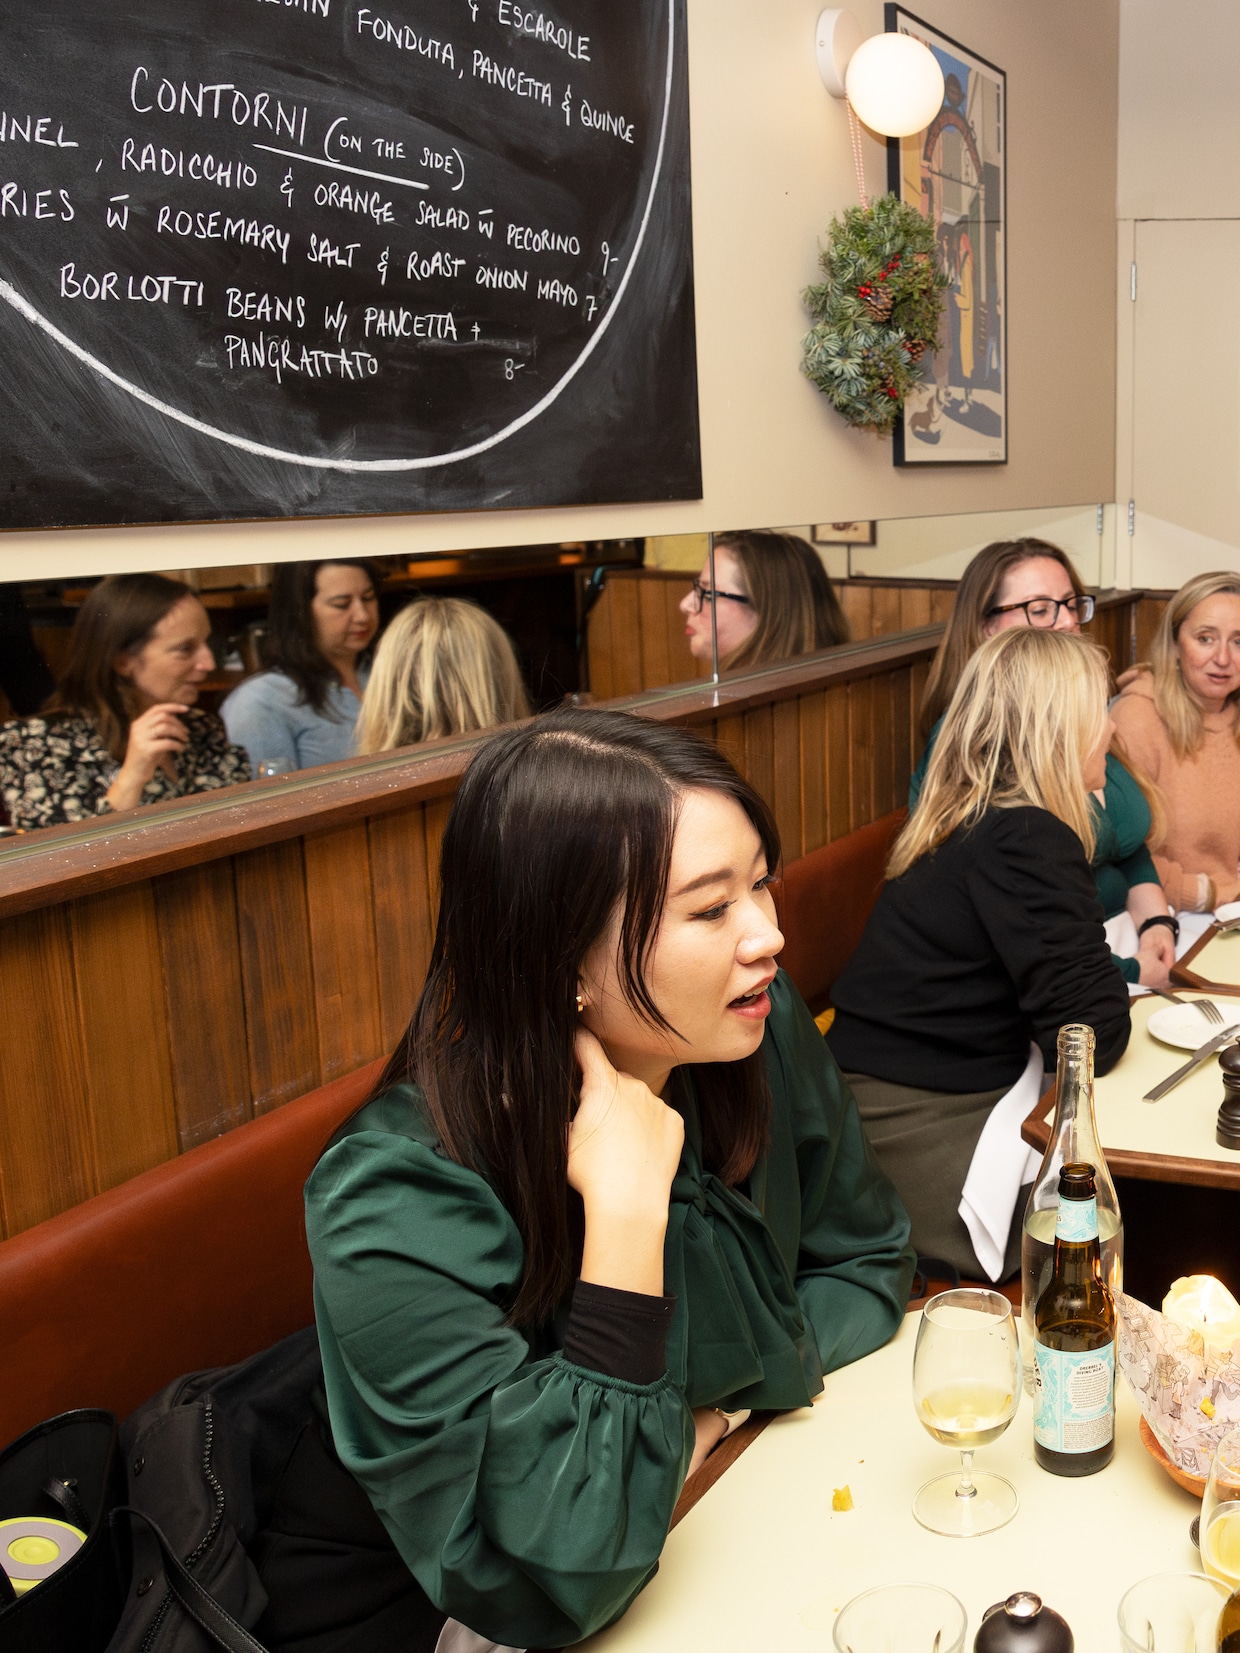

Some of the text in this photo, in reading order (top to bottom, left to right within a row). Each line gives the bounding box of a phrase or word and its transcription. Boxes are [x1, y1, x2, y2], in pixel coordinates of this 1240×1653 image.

[498, 1, 591, 61] ESCAROLE
[131, 66, 307, 146] CONTORNI
[372, 138, 406, 159] THE
[419, 147, 465, 191] SIDE)
[472, 50, 552, 107] PANCETTA
[561, 84, 572, 126] &
[580, 99, 635, 144] QUINCE
[121, 137, 257, 189] RADICCHIO
[280, 167, 294, 207] &
[314, 182, 395, 225] ORANGE
[415, 200, 470, 231] SALAD
[507, 223, 580, 255] PECORINO
[1, 181, 75, 221] RIES
[157, 205, 290, 265] ROSEMARY
[307, 233, 361, 268] SALT
[377, 246, 390, 286] &
[406, 251, 467, 281] ROAST
[475, 265, 528, 291] ONION
[537, 278, 578, 307] MAYO
[224, 331, 379, 384] PANGRATTATO
[225, 287, 306, 329] BEANS
[364, 306, 457, 341] PANCETTA
